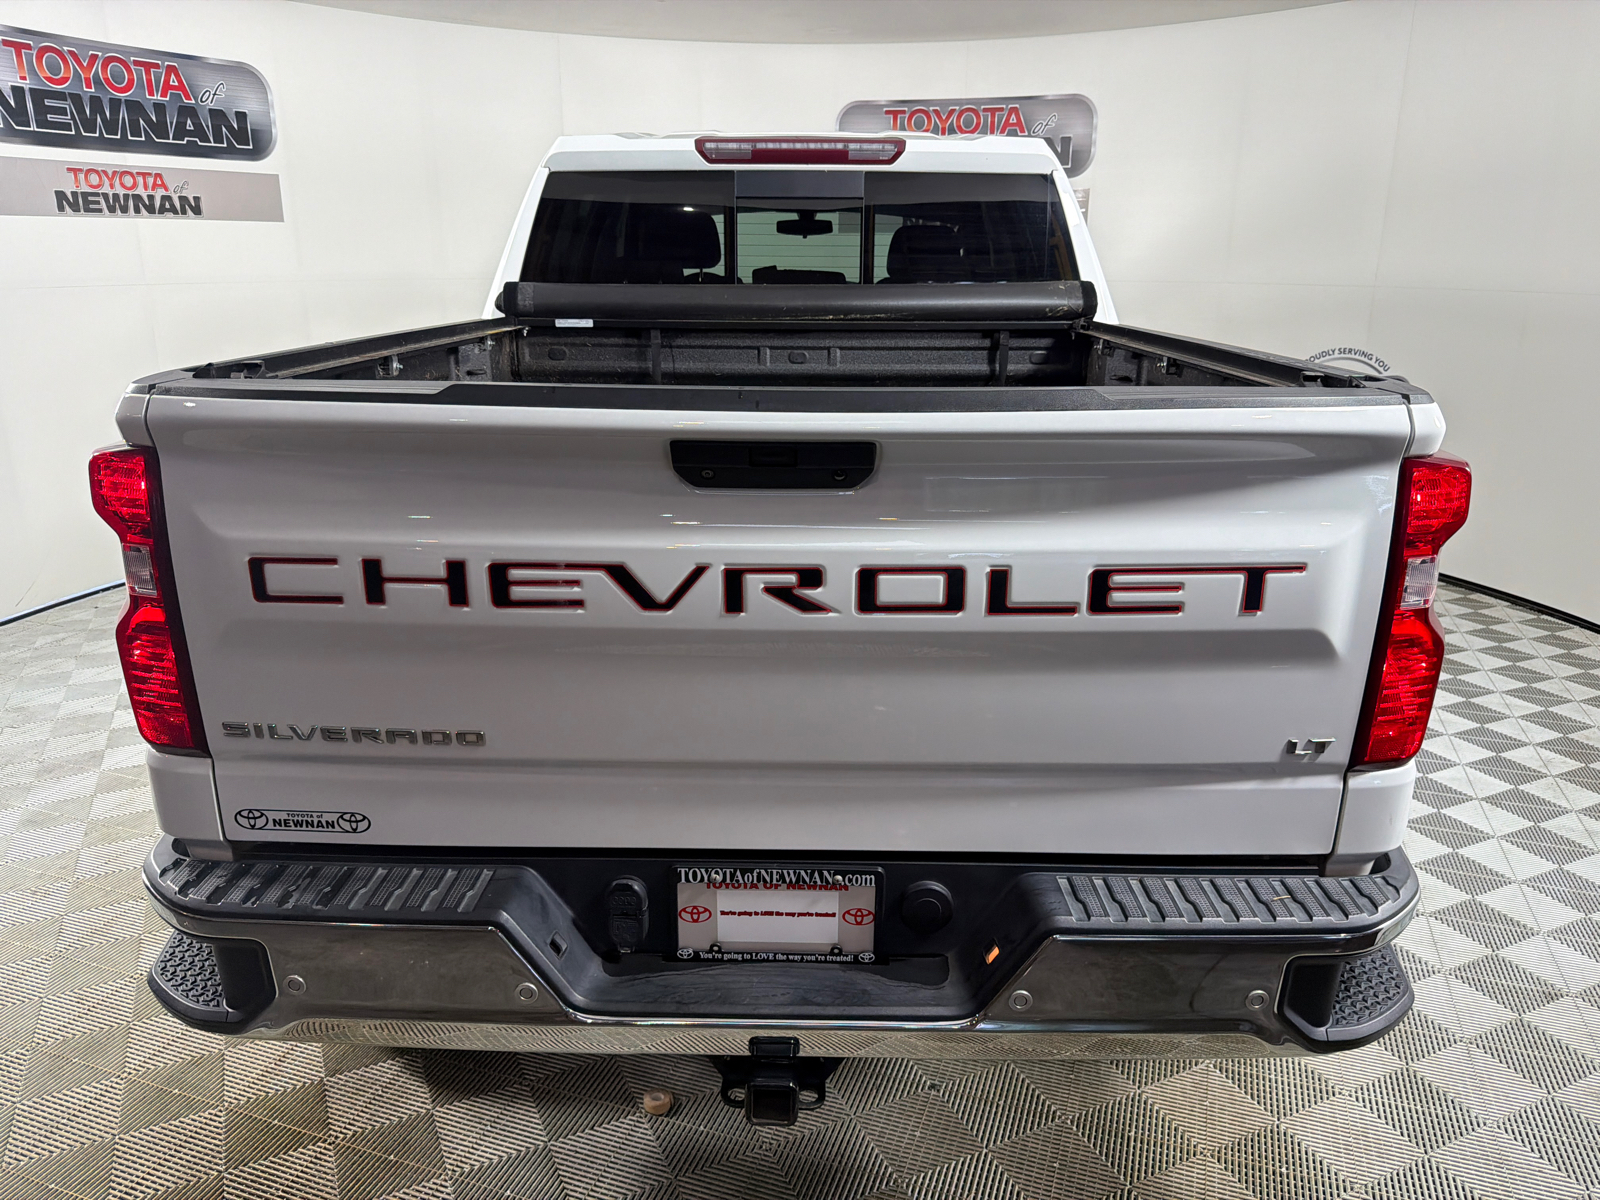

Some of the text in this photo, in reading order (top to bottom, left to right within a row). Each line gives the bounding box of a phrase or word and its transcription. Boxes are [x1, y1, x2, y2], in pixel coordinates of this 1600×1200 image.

[0, 37, 226, 105] TOYOTA of
[0, 83, 253, 149] NEWNAN
[883, 104, 1057, 136] TOYOTA of
[66, 167, 189, 194] TOYOTA of
[54, 189, 203, 216] NEWNAN
[1305, 347, 1391, 372] OUDLY SERVING YOU
[247, 555, 1307, 616] CHEVROLET
[221, 721, 486, 746] SILVERADO
[1285, 737, 1336, 755] LT
[272, 818, 336, 829] NEWNAN
[699, 951, 722, 959] You're
[723, 952, 742, 961] going
[743, 952, 751, 960] to
[752, 952, 774, 960] LOVE
[775, 953, 786, 961] the
[802, 954, 825, 963] you're
[826, 954, 854, 962] treated!
